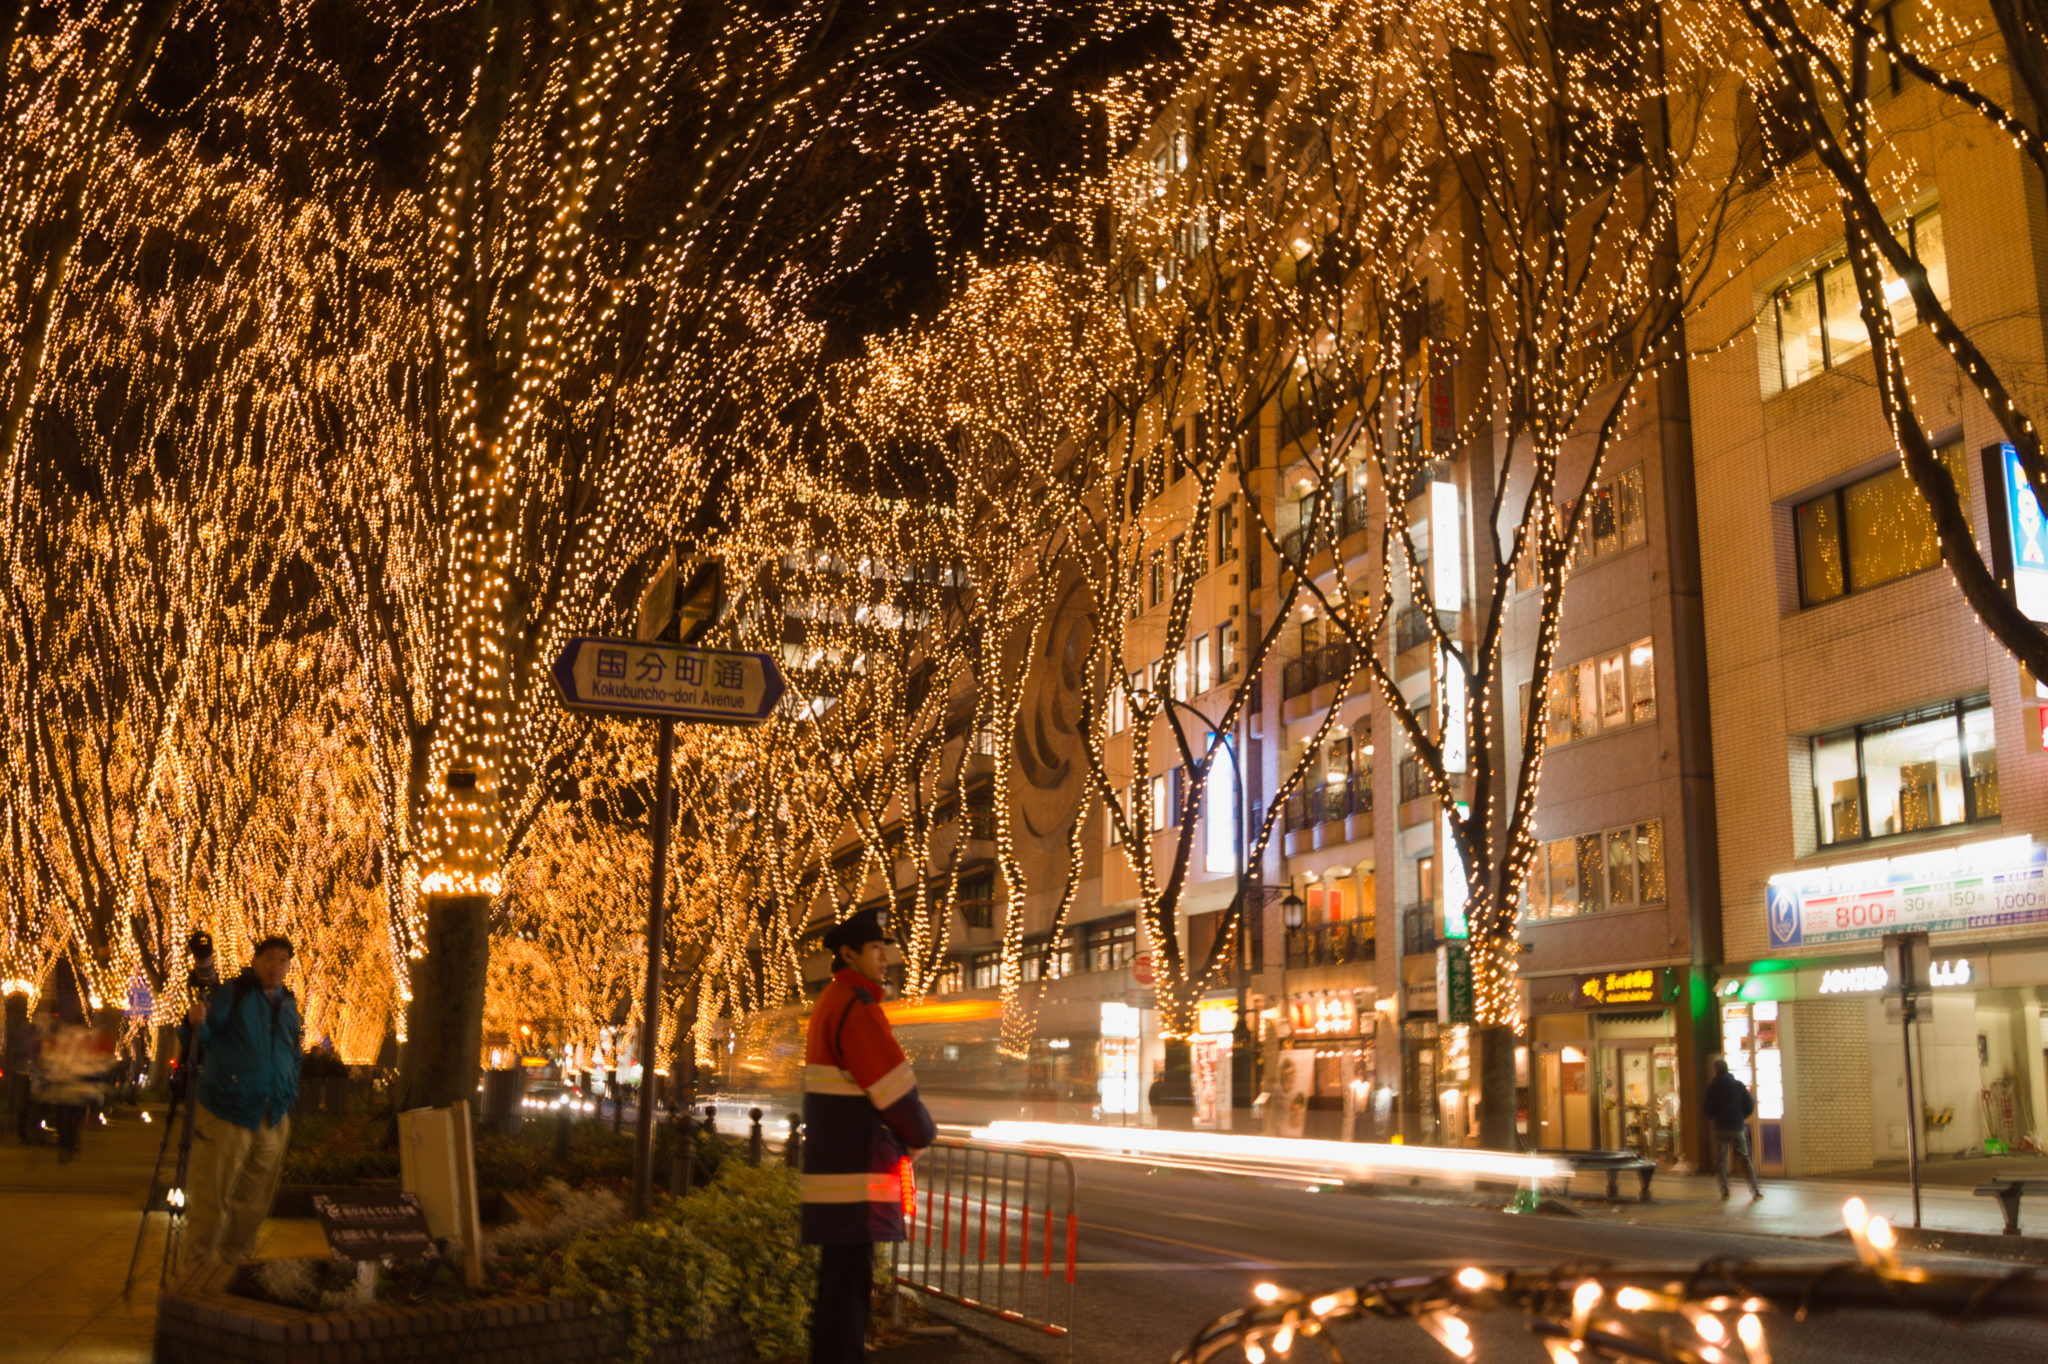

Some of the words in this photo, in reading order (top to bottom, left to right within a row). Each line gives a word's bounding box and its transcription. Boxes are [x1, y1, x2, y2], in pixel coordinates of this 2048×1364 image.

[597, 649, 745, 690] 国分町通
[592, 679, 697, 705] Kokubuncho-dori
[701, 692, 745, 709] Avenue
